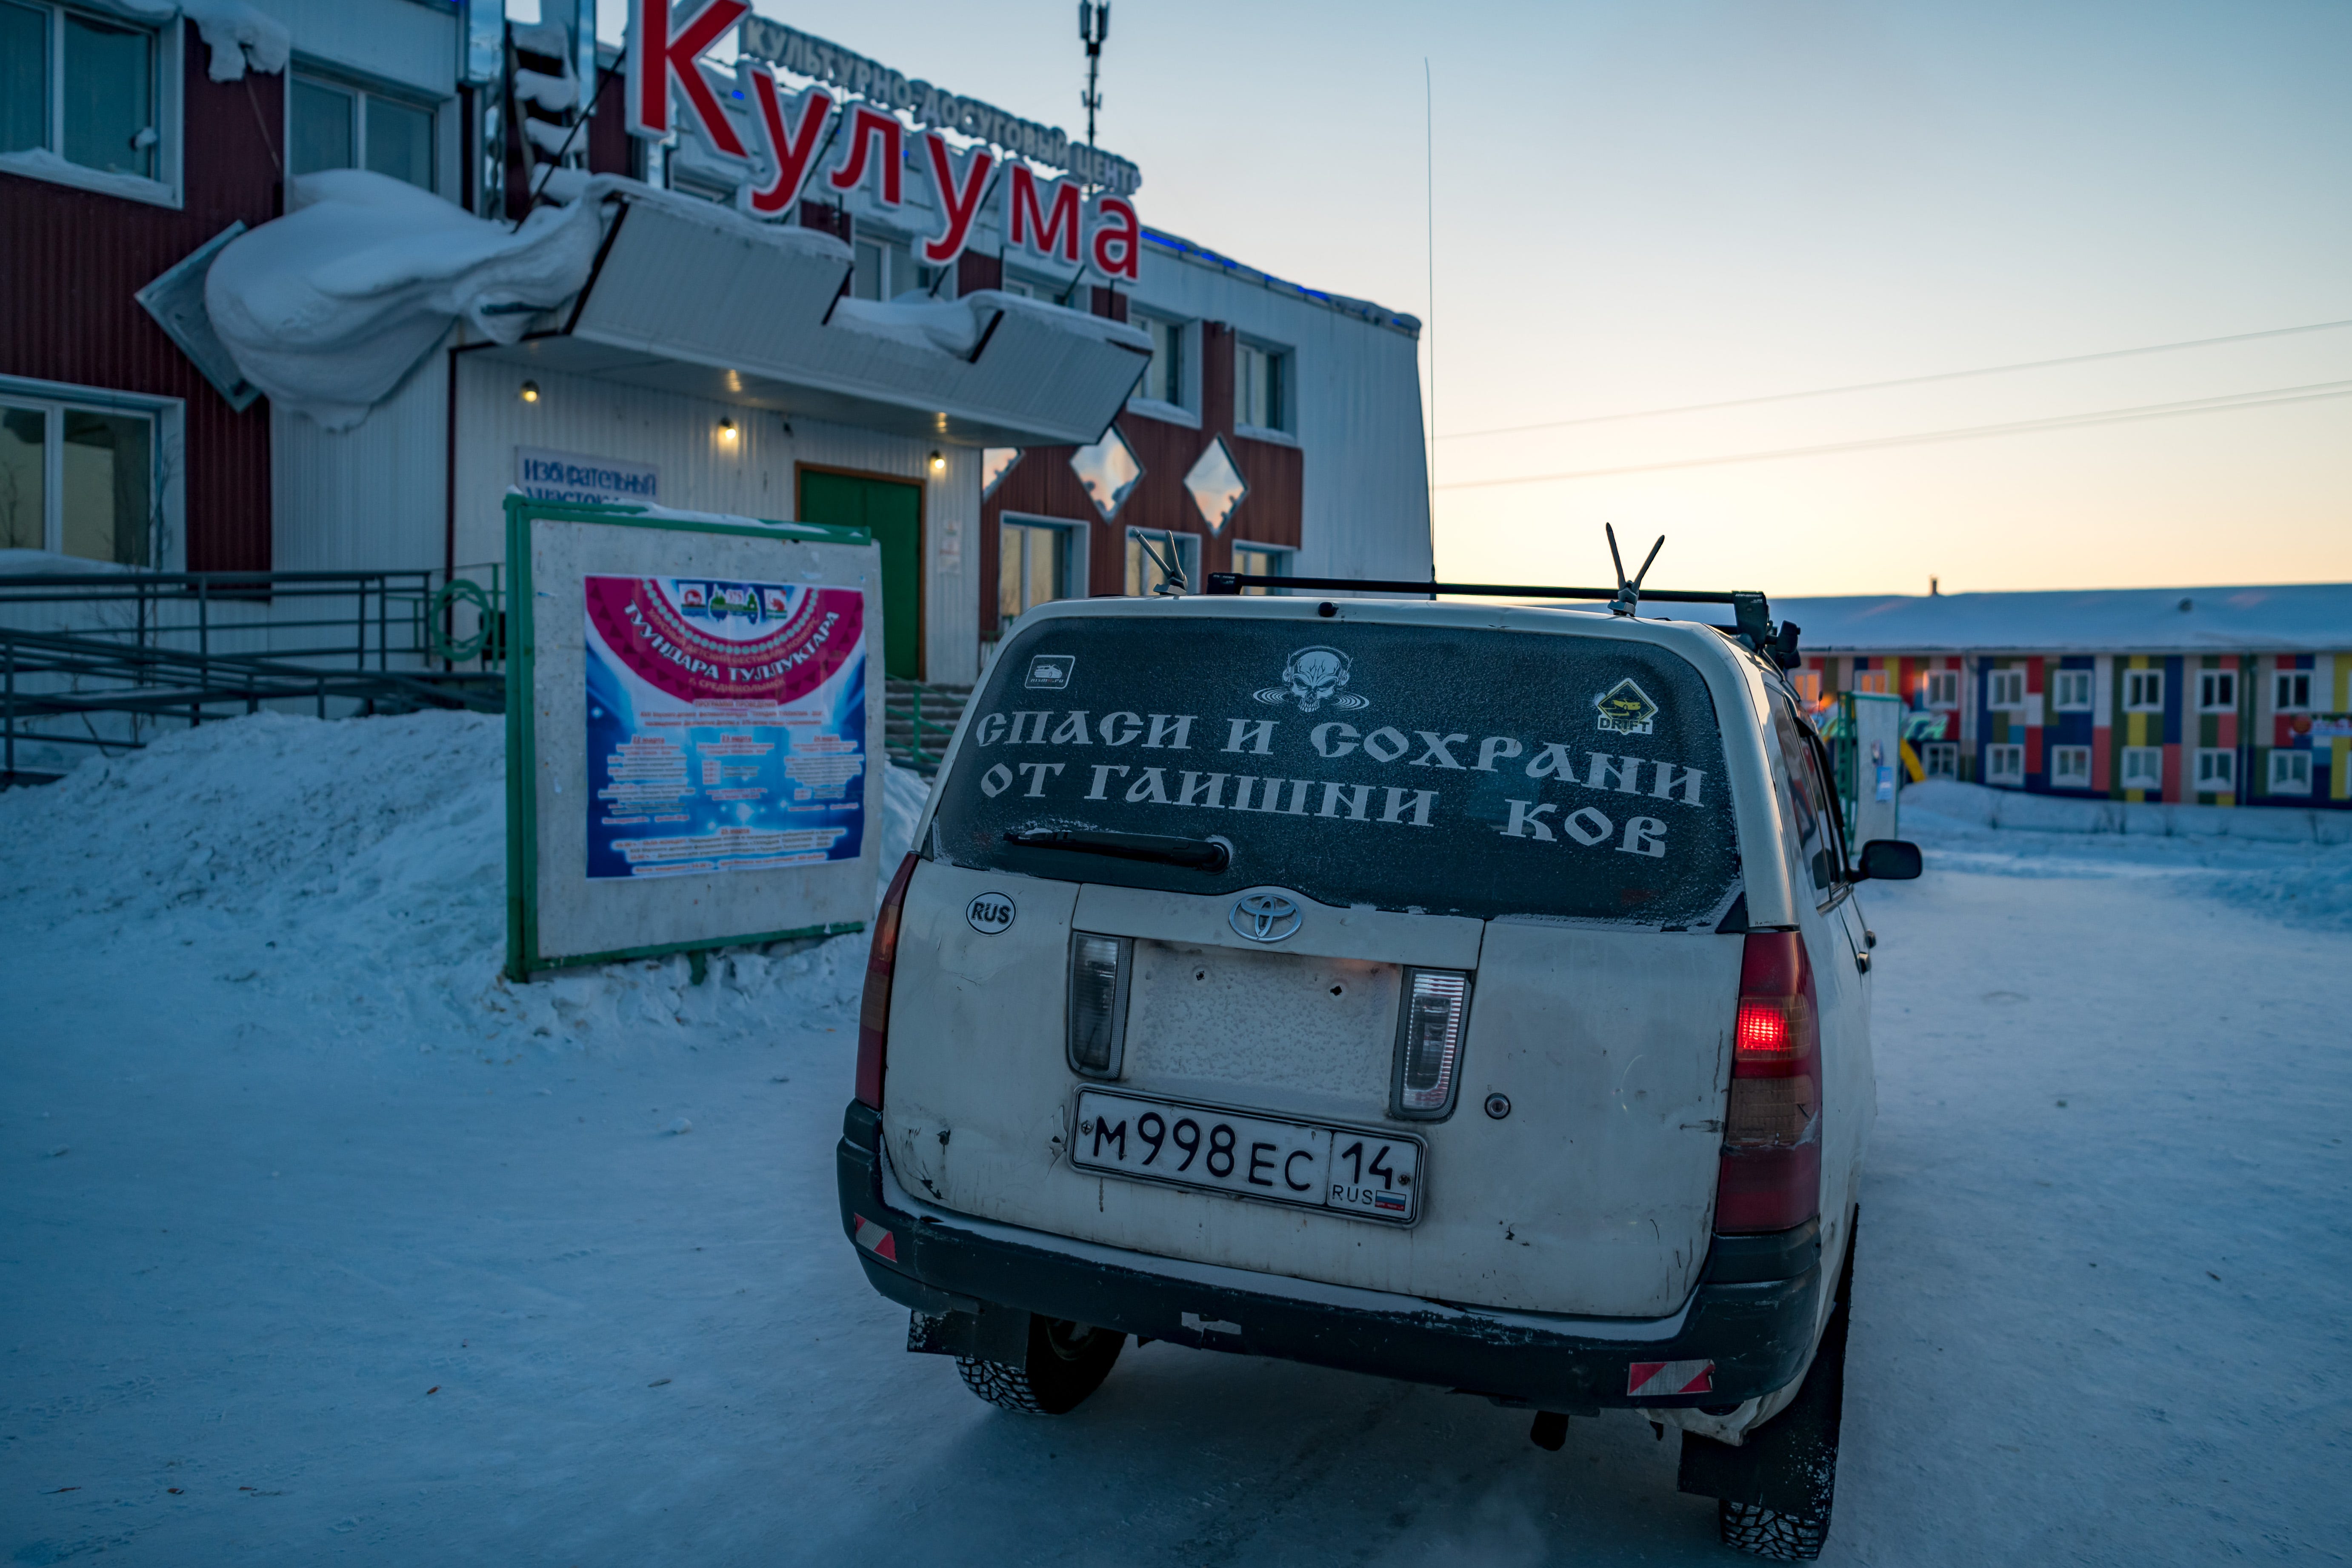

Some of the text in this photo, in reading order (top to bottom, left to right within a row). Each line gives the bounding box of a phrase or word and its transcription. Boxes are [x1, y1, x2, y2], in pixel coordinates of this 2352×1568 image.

[745, 18, 1142, 191] КУЛЬТУРНО-ДОСУГОВЫЙ ЦЕНТР
[523, 458, 657, 496] Избирательный
[623, 599, 840, 682] ТУУНДАРА ТУЛЛУКТАРА
[975, 711, 1198, 749] СПАСИ
[1220, 717, 1280, 755] И
[1599, 717, 1650, 733] DRIFT
[980, 762, 1066, 798] ОТ
[970, 901, 1012, 925] RUS
[1341, 1141, 1393, 1190] 14
[1332, 1184, 1373, 1205] RUS
